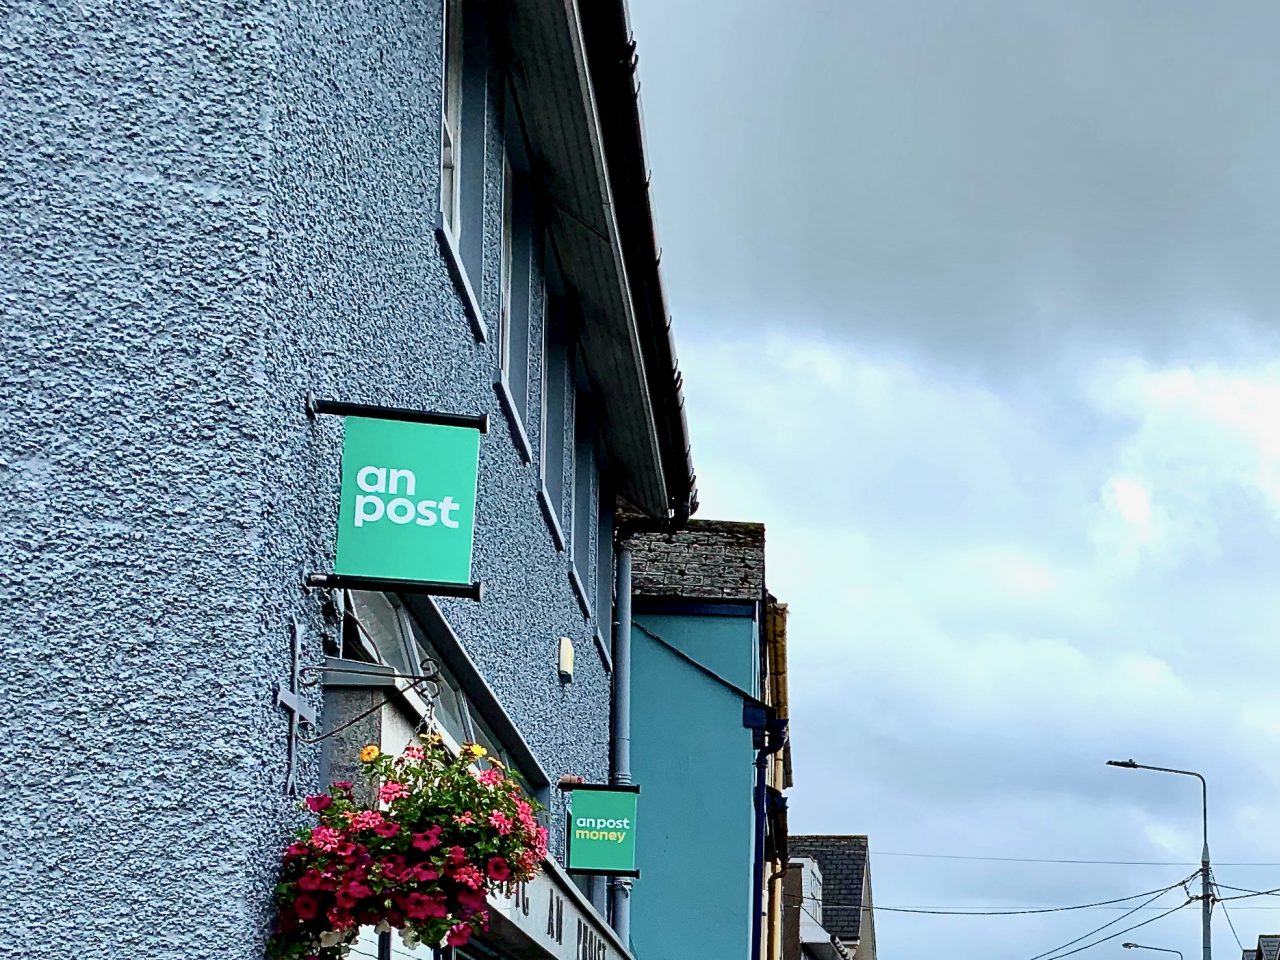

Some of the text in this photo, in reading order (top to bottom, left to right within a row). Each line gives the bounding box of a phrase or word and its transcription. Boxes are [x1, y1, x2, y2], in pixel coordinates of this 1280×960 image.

[356, 465, 416, 496] an
[354, 494, 460, 529] post
[575, 829, 626, 844] money
[547, 888, 563, 945] AN
